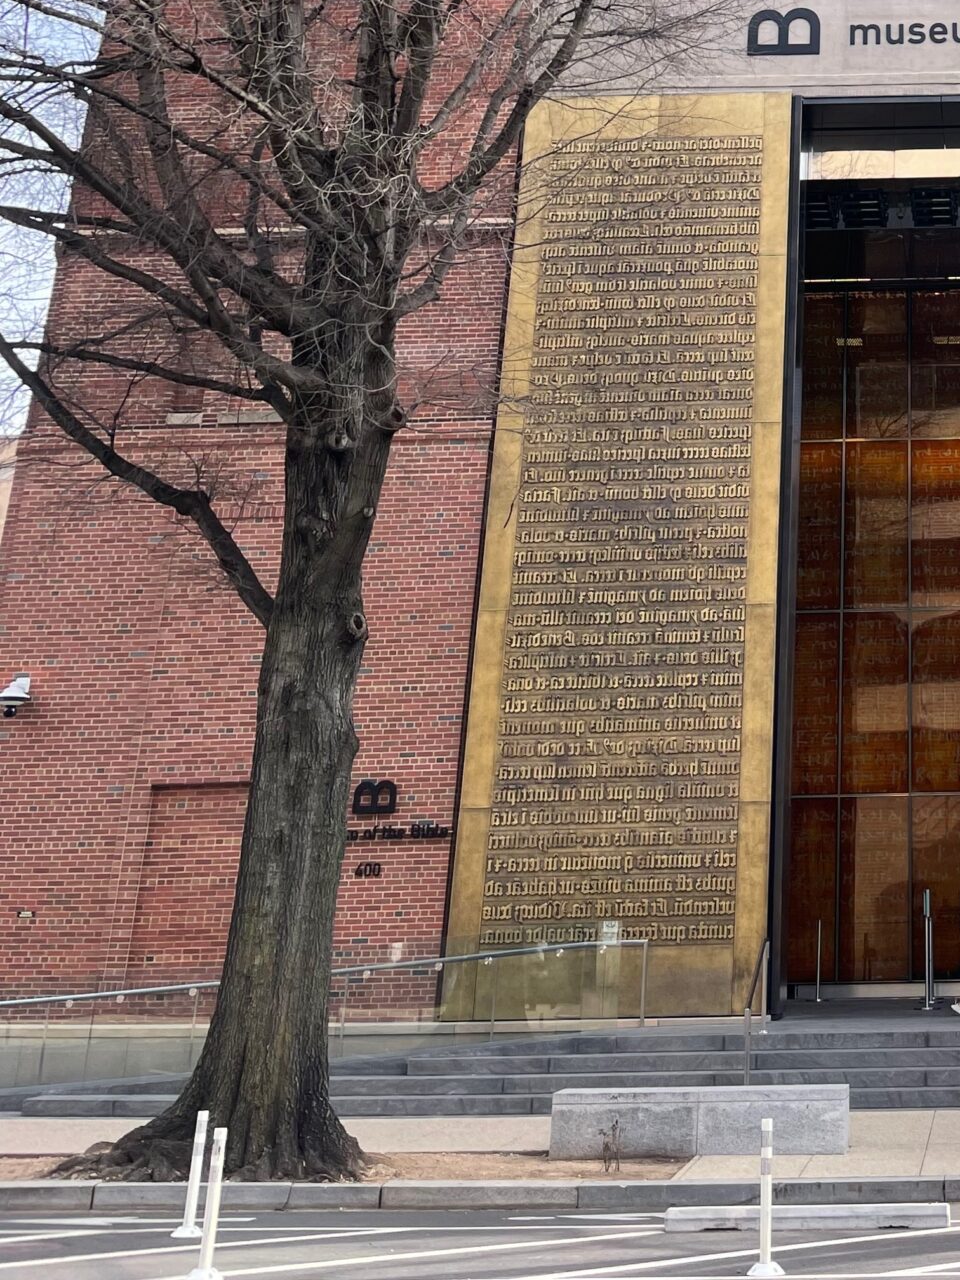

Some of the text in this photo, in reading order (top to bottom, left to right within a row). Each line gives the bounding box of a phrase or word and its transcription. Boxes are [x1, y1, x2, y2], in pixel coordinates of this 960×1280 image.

[382, 825, 406, 839] the
[411, 823, 449, 839] Bible
[355, 863, 381, 877] 400
